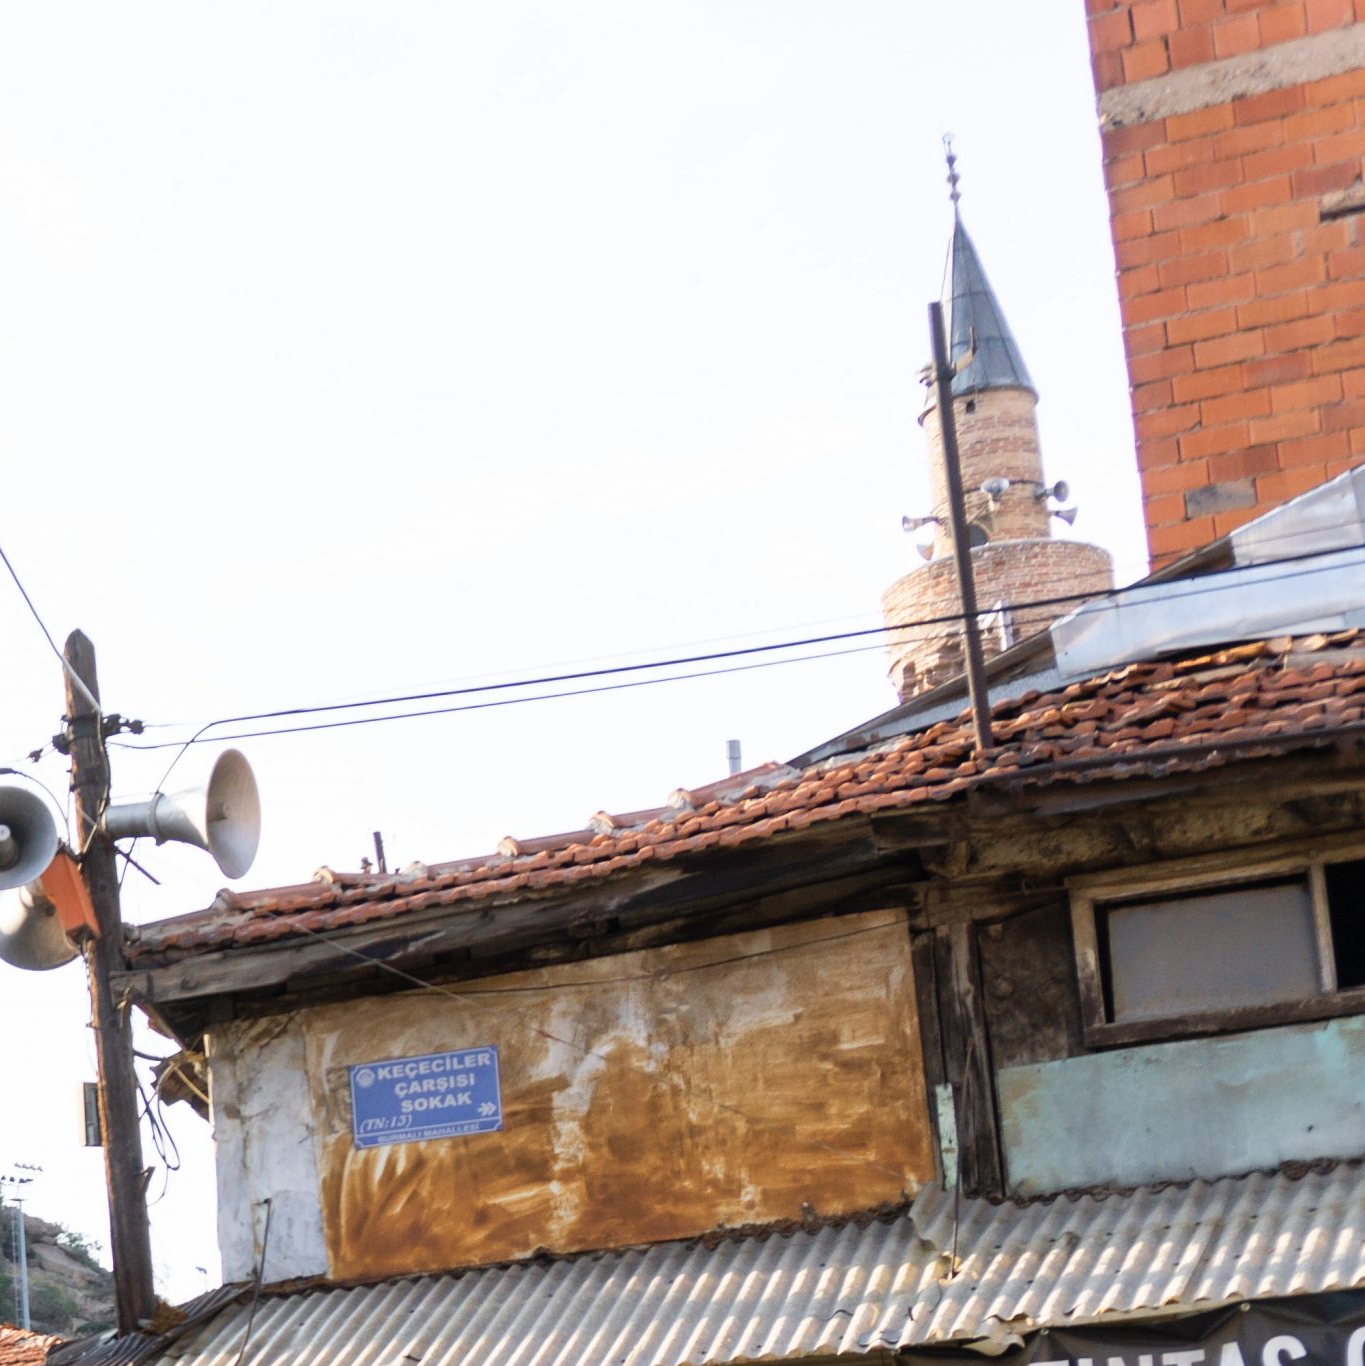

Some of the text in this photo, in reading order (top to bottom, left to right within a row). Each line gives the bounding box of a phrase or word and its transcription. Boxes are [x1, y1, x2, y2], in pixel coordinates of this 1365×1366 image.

[377, 1052, 491, 1080] KEÇECİLER
[394, 1073, 476, 1098] ÇARŞISI
[401, 1092, 472, 1113] SOKAK
